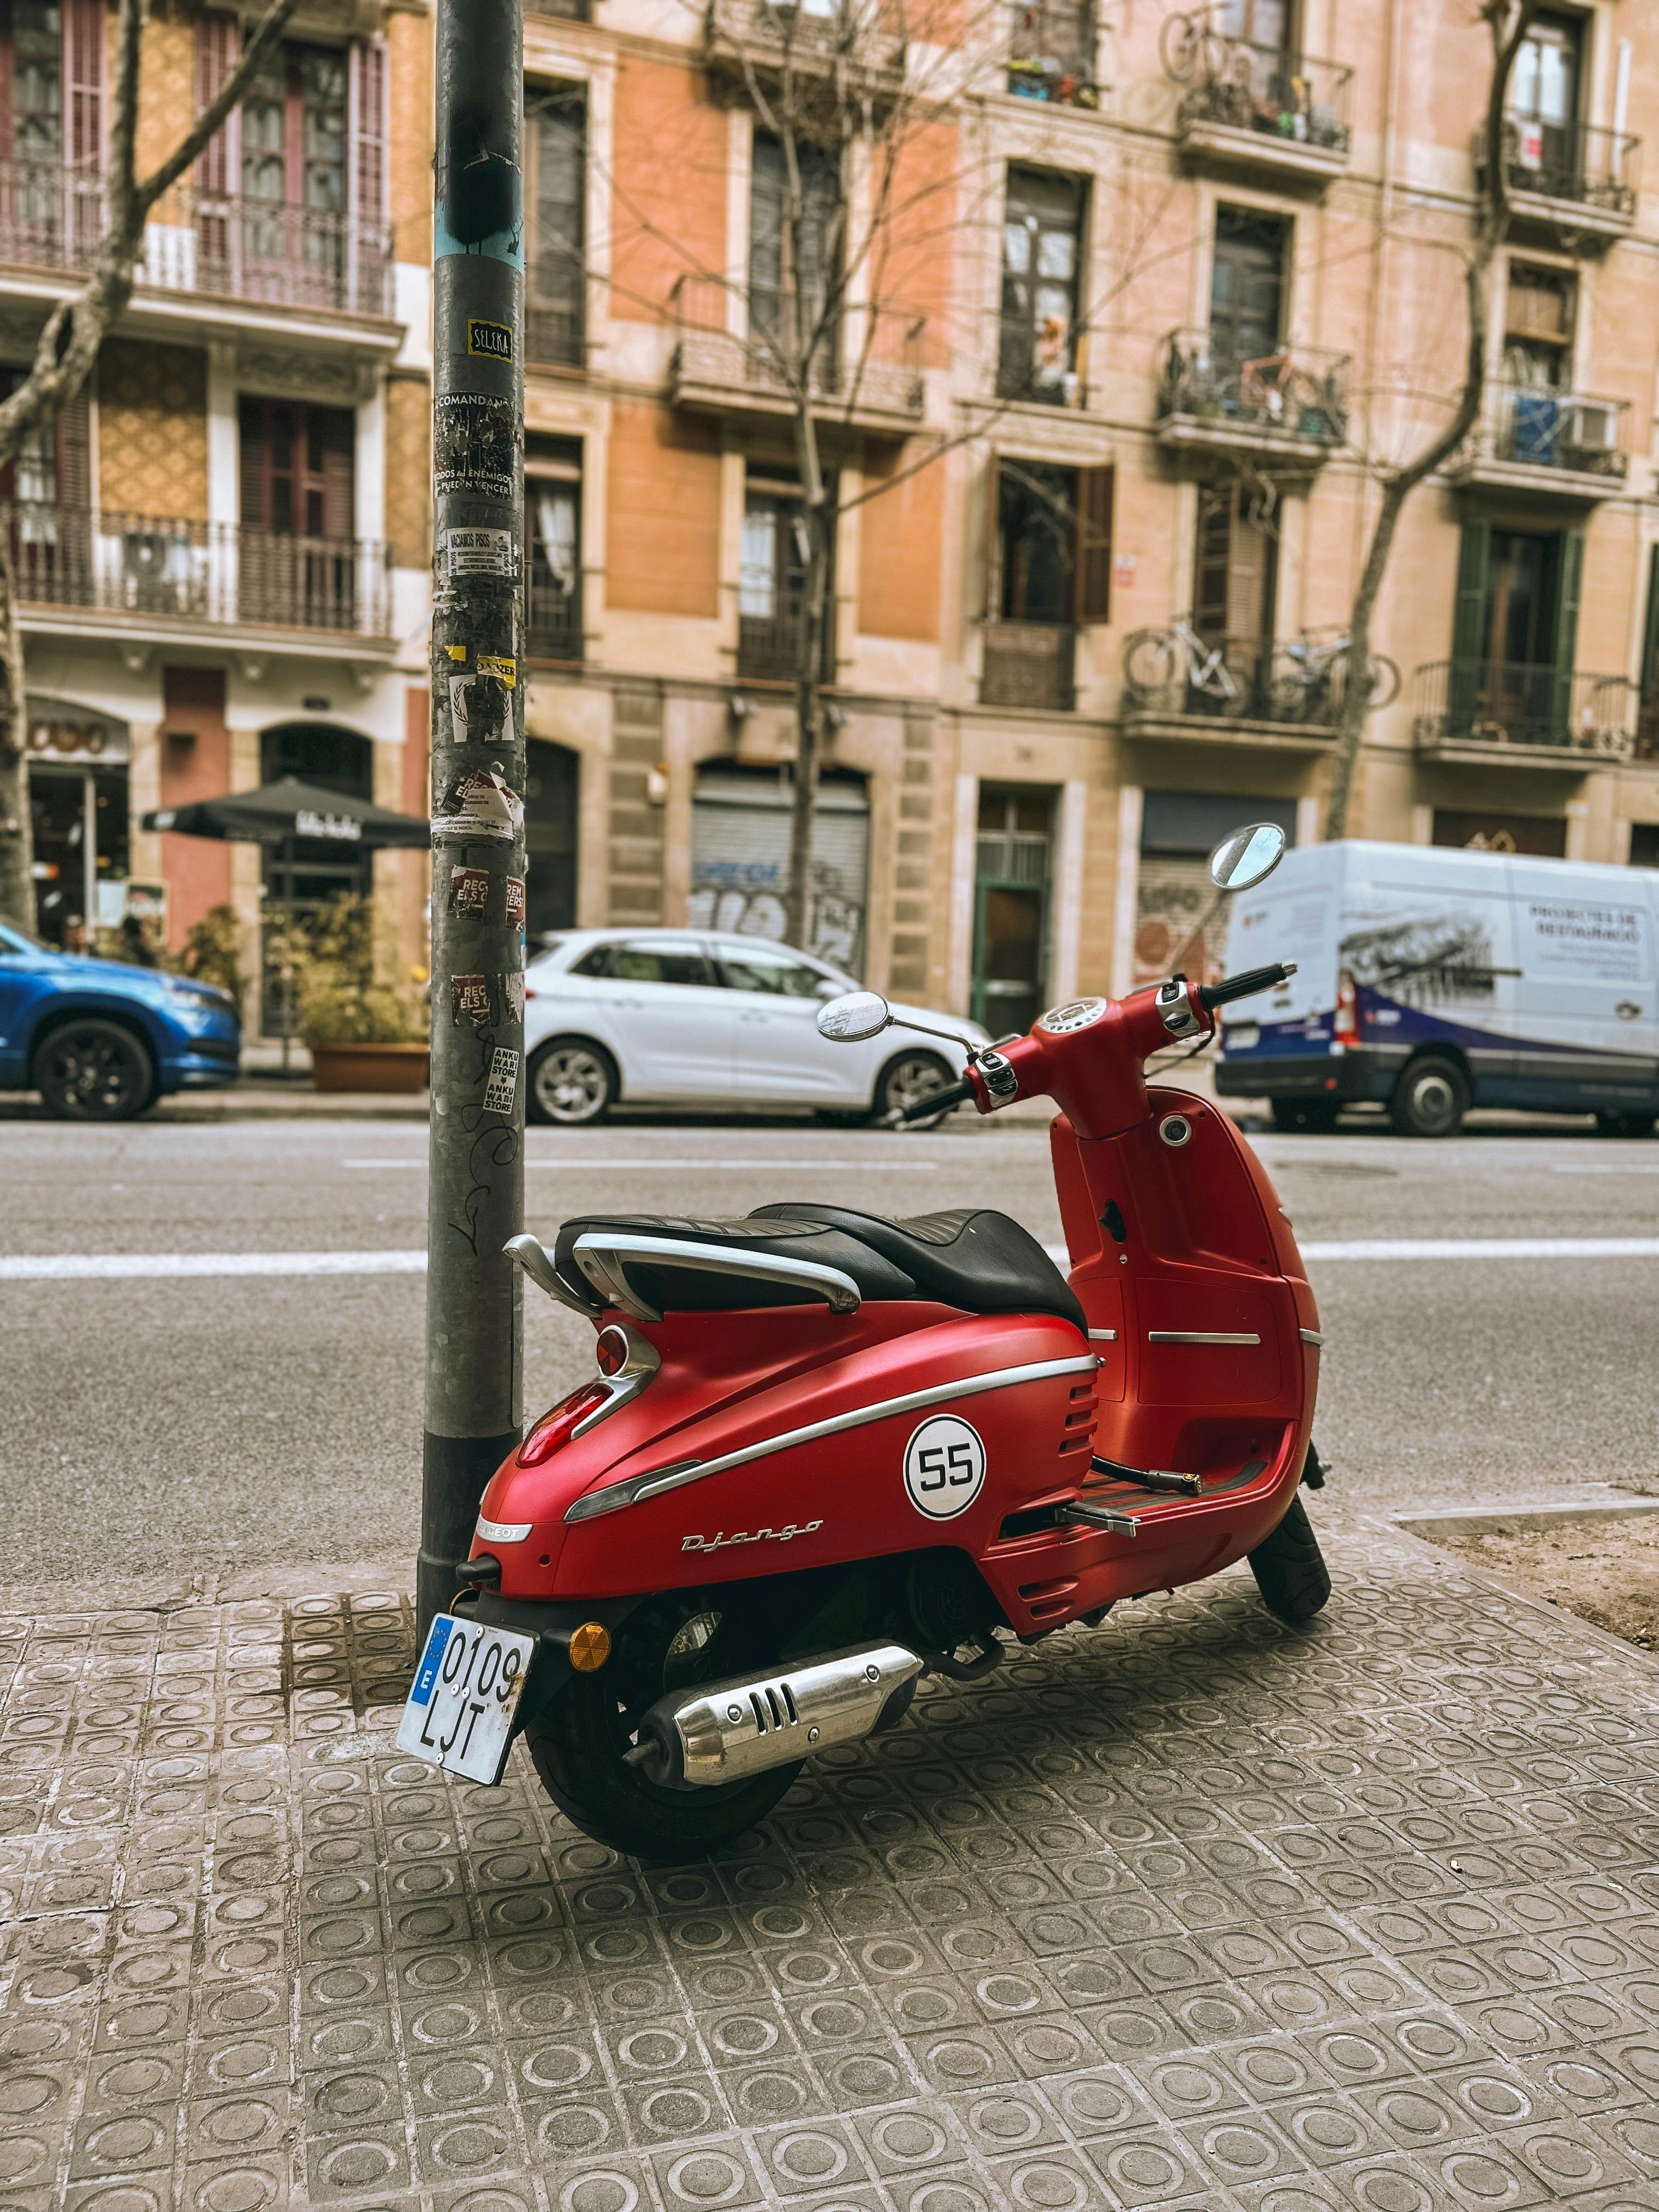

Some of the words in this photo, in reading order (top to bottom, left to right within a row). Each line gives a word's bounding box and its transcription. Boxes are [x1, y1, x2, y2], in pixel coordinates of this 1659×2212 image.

[475, 329, 508, 354] SELEKA
[475, 533, 490, 548] PISOS
[495, 1049, 518, 1061] ANKU
[492, 1065, 516, 1078] STORE
[488, 1084, 514, 1095] ANKU
[484, 1100, 511, 1112] STORE
[918, 1442, 973, 1492] 55
[681, 1520, 824, 1553] Django
[442, 1632, 521, 1703] 0109
[420, 1669, 433, 1690] E
[420, 1689, 485, 1759] LJT
